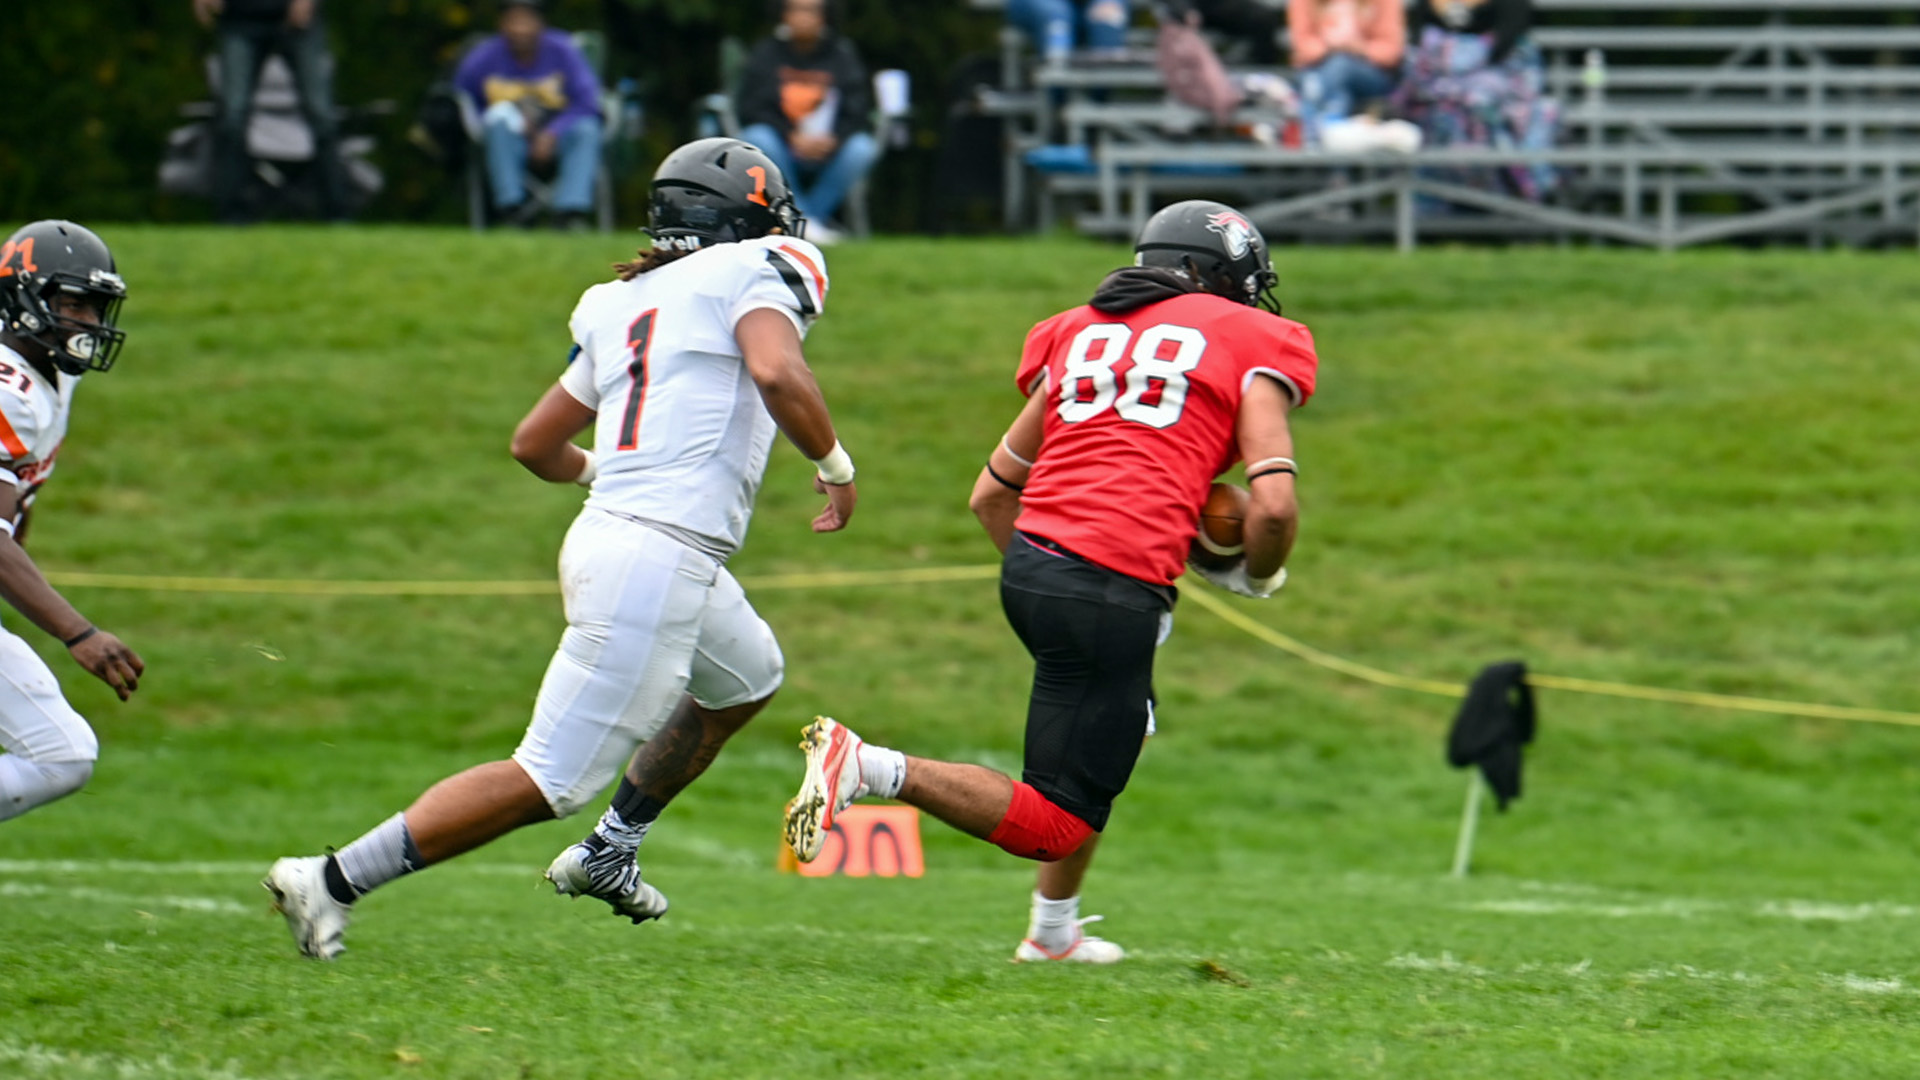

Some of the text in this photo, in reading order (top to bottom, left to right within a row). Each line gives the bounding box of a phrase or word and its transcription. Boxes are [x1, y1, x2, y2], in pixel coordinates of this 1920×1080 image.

[746, 165, 769, 207] 1
[0, 237, 38, 277] 21
[0, 361, 33, 394] 21
[616, 307, 659, 451] 1
[1056, 322, 1208, 429] 88
